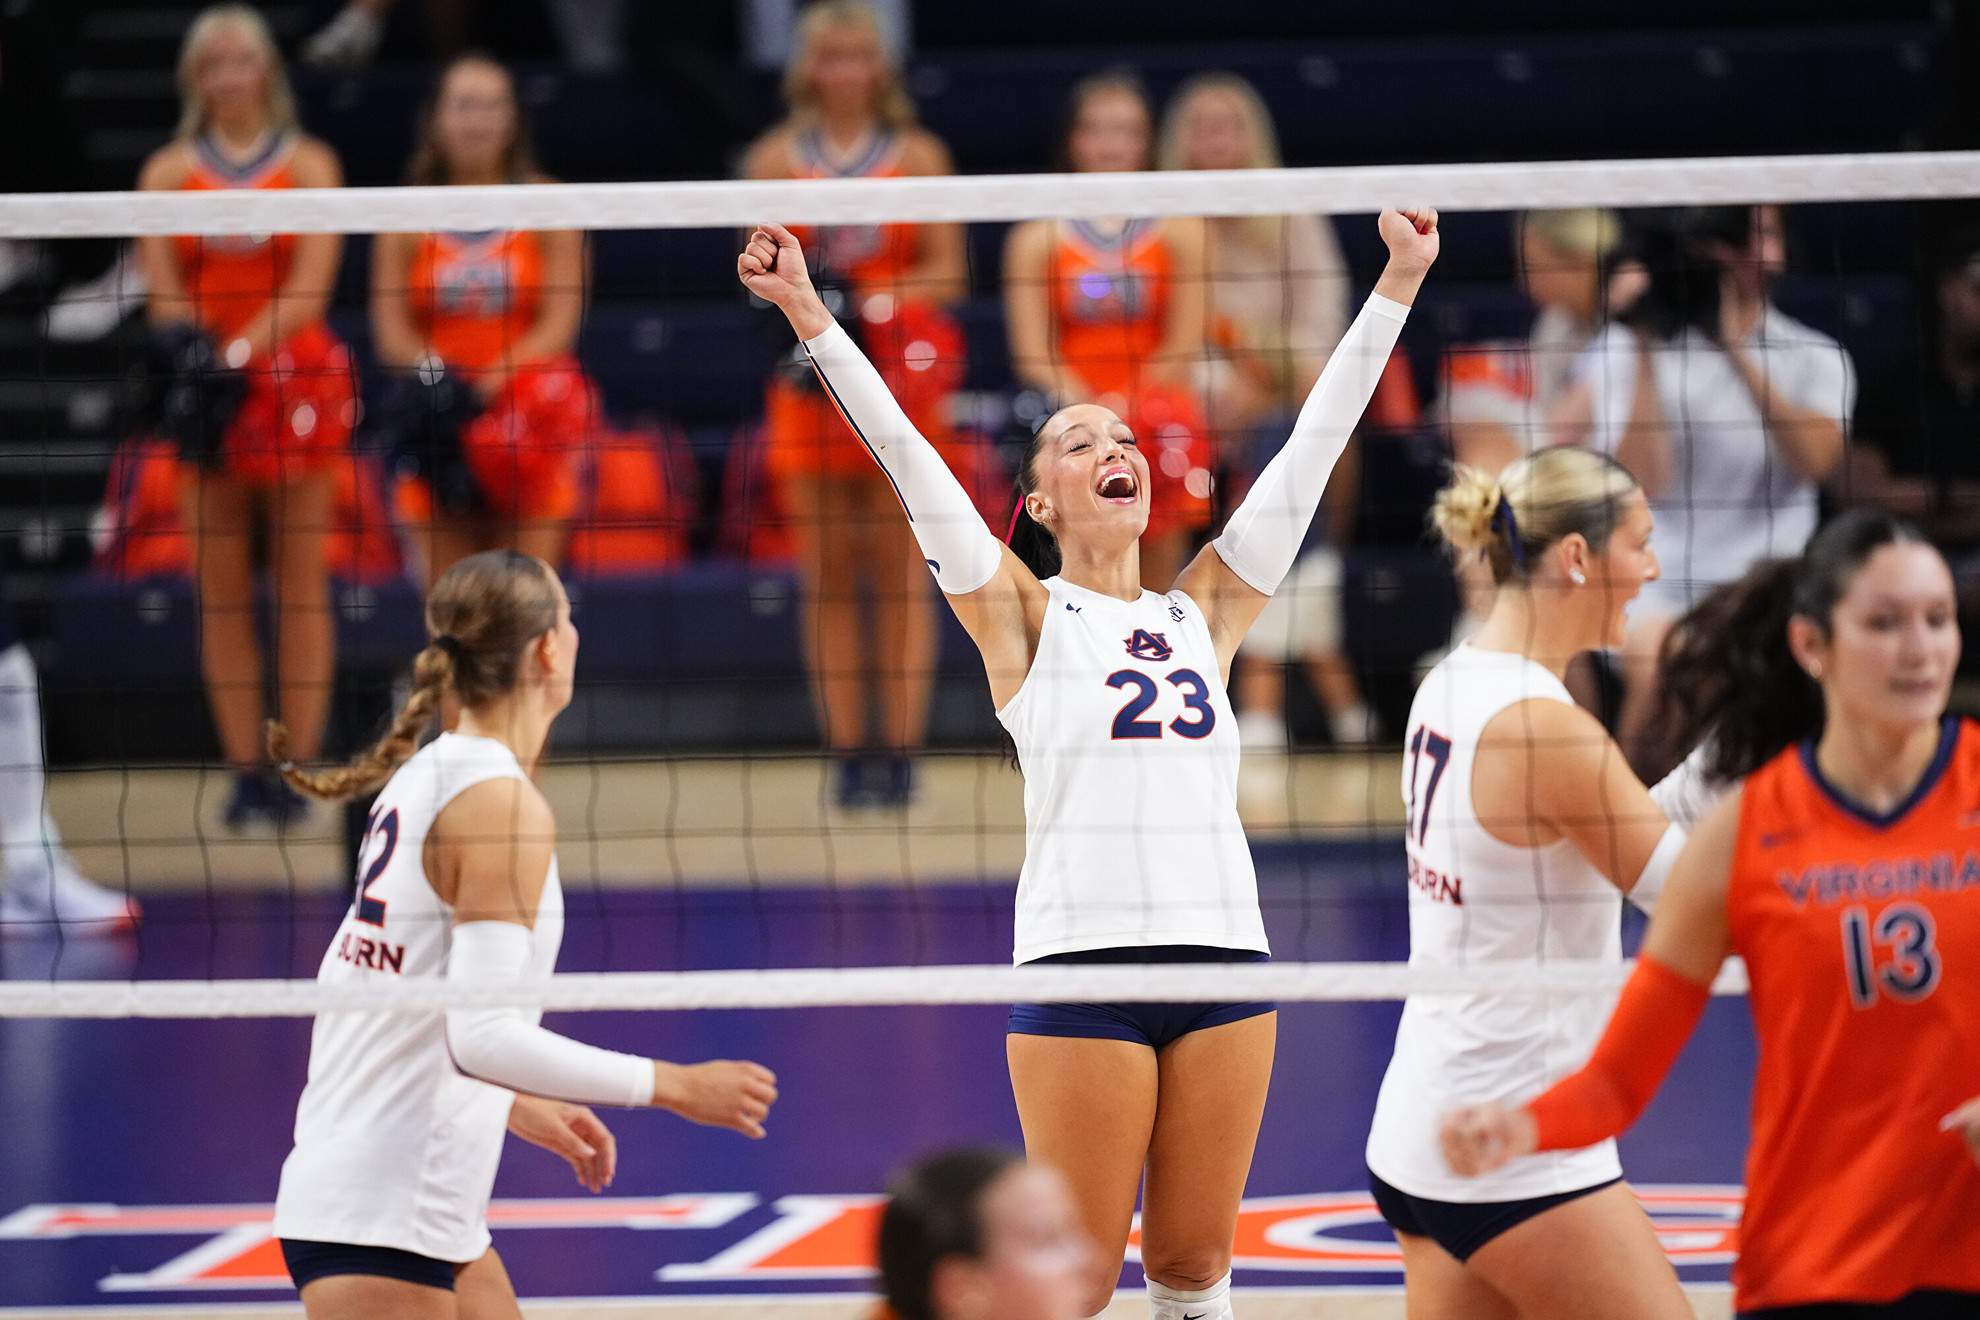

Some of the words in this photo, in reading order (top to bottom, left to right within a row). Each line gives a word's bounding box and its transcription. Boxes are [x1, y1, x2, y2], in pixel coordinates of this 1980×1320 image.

[1104, 667, 1216, 740] 23
[1411, 724, 1452, 846] 17
[1840, 901, 1943, 1010] 13
